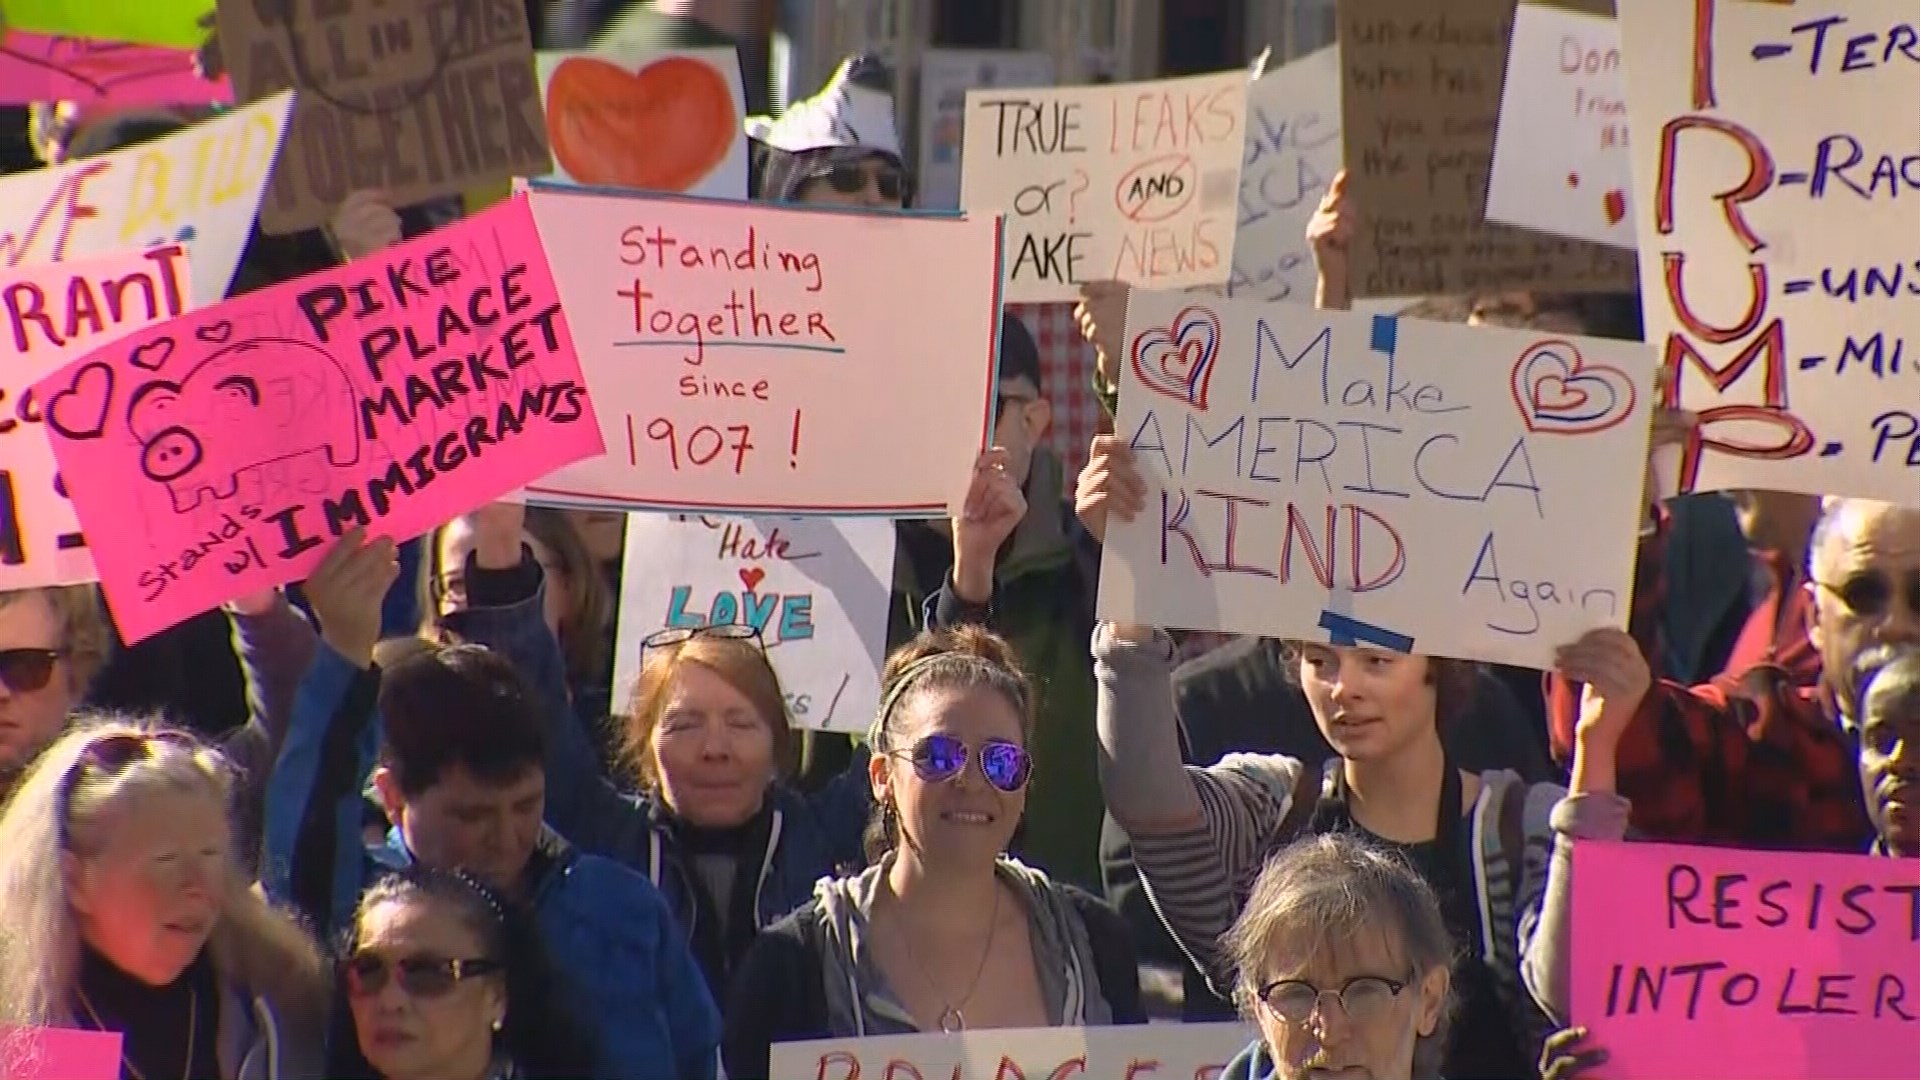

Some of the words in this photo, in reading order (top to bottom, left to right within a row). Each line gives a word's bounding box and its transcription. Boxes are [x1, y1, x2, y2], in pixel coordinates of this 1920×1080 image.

[368, 18, 413, 60] IN
[273, 59, 549, 210] TOGETHER
[979, 100, 1087, 157] TRUE
[1109, 84, 1240, 155] LEAKS
[1127, 173, 1185, 203] AND
[298, 247, 460, 342] PIKE
[1011, 232, 1095, 285] AKE
[1113, 219, 1220, 281] NEWS
[360, 264, 532, 381] PLACE
[1251, 318, 1472, 413] Make
[359, 303, 562, 440] MARKET
[264, 380, 586, 558] IMMIGRANTS
[626, 413, 755, 474] 1907
[1129, 410, 1544, 518] AMERICA
[718, 523, 822, 560] Hate
[1160, 487, 1407, 593] KIND
[1462, 531, 1617, 635] Again
[665, 585, 815, 641] LOVE
[1667, 864, 1920, 942] RESIST
[1606, 961, 1917, 1021] INTOLER
